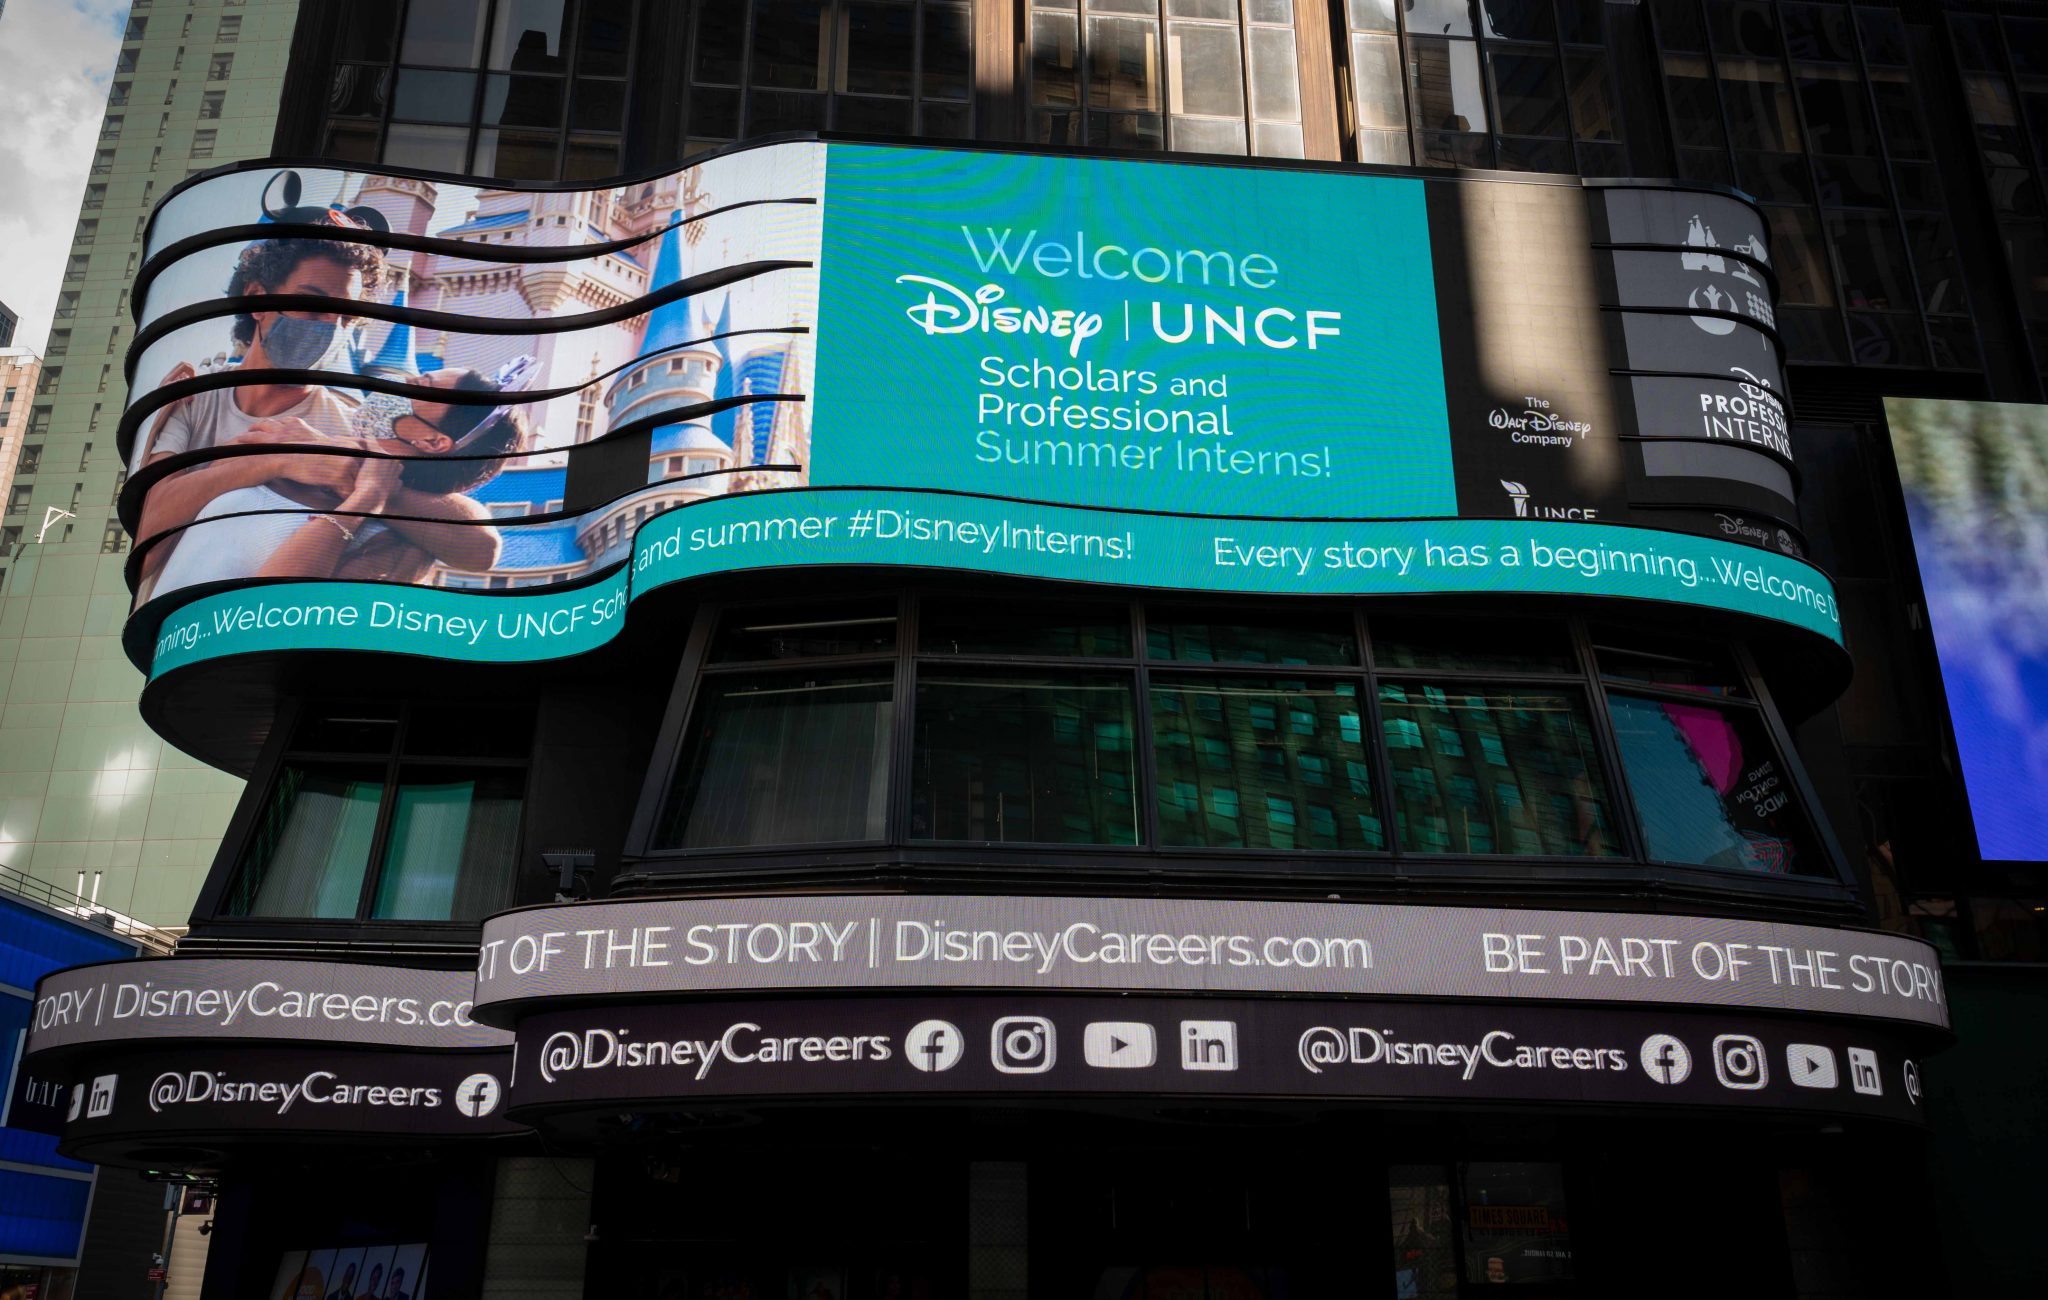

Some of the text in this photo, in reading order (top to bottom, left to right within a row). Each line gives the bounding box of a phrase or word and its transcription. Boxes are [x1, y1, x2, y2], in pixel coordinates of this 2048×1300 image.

[961, 226, 1279, 289] Welcome
[896, 274, 1102, 357] Disney
[1151, 301, 1342, 350] UNCF
[978, 356, 1228, 398] Scholars and
[978, 394, 1234, 436] Professional
[1524, 410, 1591, 439] Disney
[1525, 396, 1550, 409] The
[975, 430, 1331, 478] Summer Interns!
[1511, 432, 1572, 447] Company
[1703, 415, 1793, 461] INTERNS
[638, 527, 680, 572] and
[689, 513, 836, 551] summer
[848, 508, 1134, 559] #DisneyInterns!
[1714, 513, 1769, 547] Disney
[1214, 537, 1312, 576] Every
[1324, 541, 1414, 576] story
[1425, 539, 1488, 568] has
[1500, 545, 1520, 568] a
[370, 601, 488, 645] Disney
[497, 604, 587, 639] UNCF
[510, 931, 567, 975] OF
[576, 926, 673, 970] THE
[684, 920, 859, 966] STORY
[895, 919, 1373, 974] DisneyCareers.com
[1482, 932, 1941, 1004] BE PART OF THE STORY
[114, 980, 474, 1028] DisneyCareers.co
[540, 1022, 892, 1084] @DisneyCareers
[1298, 1026, 1628, 1082] @DisneyCareers
[149, 1070, 442, 1115] @DisneyCareers
